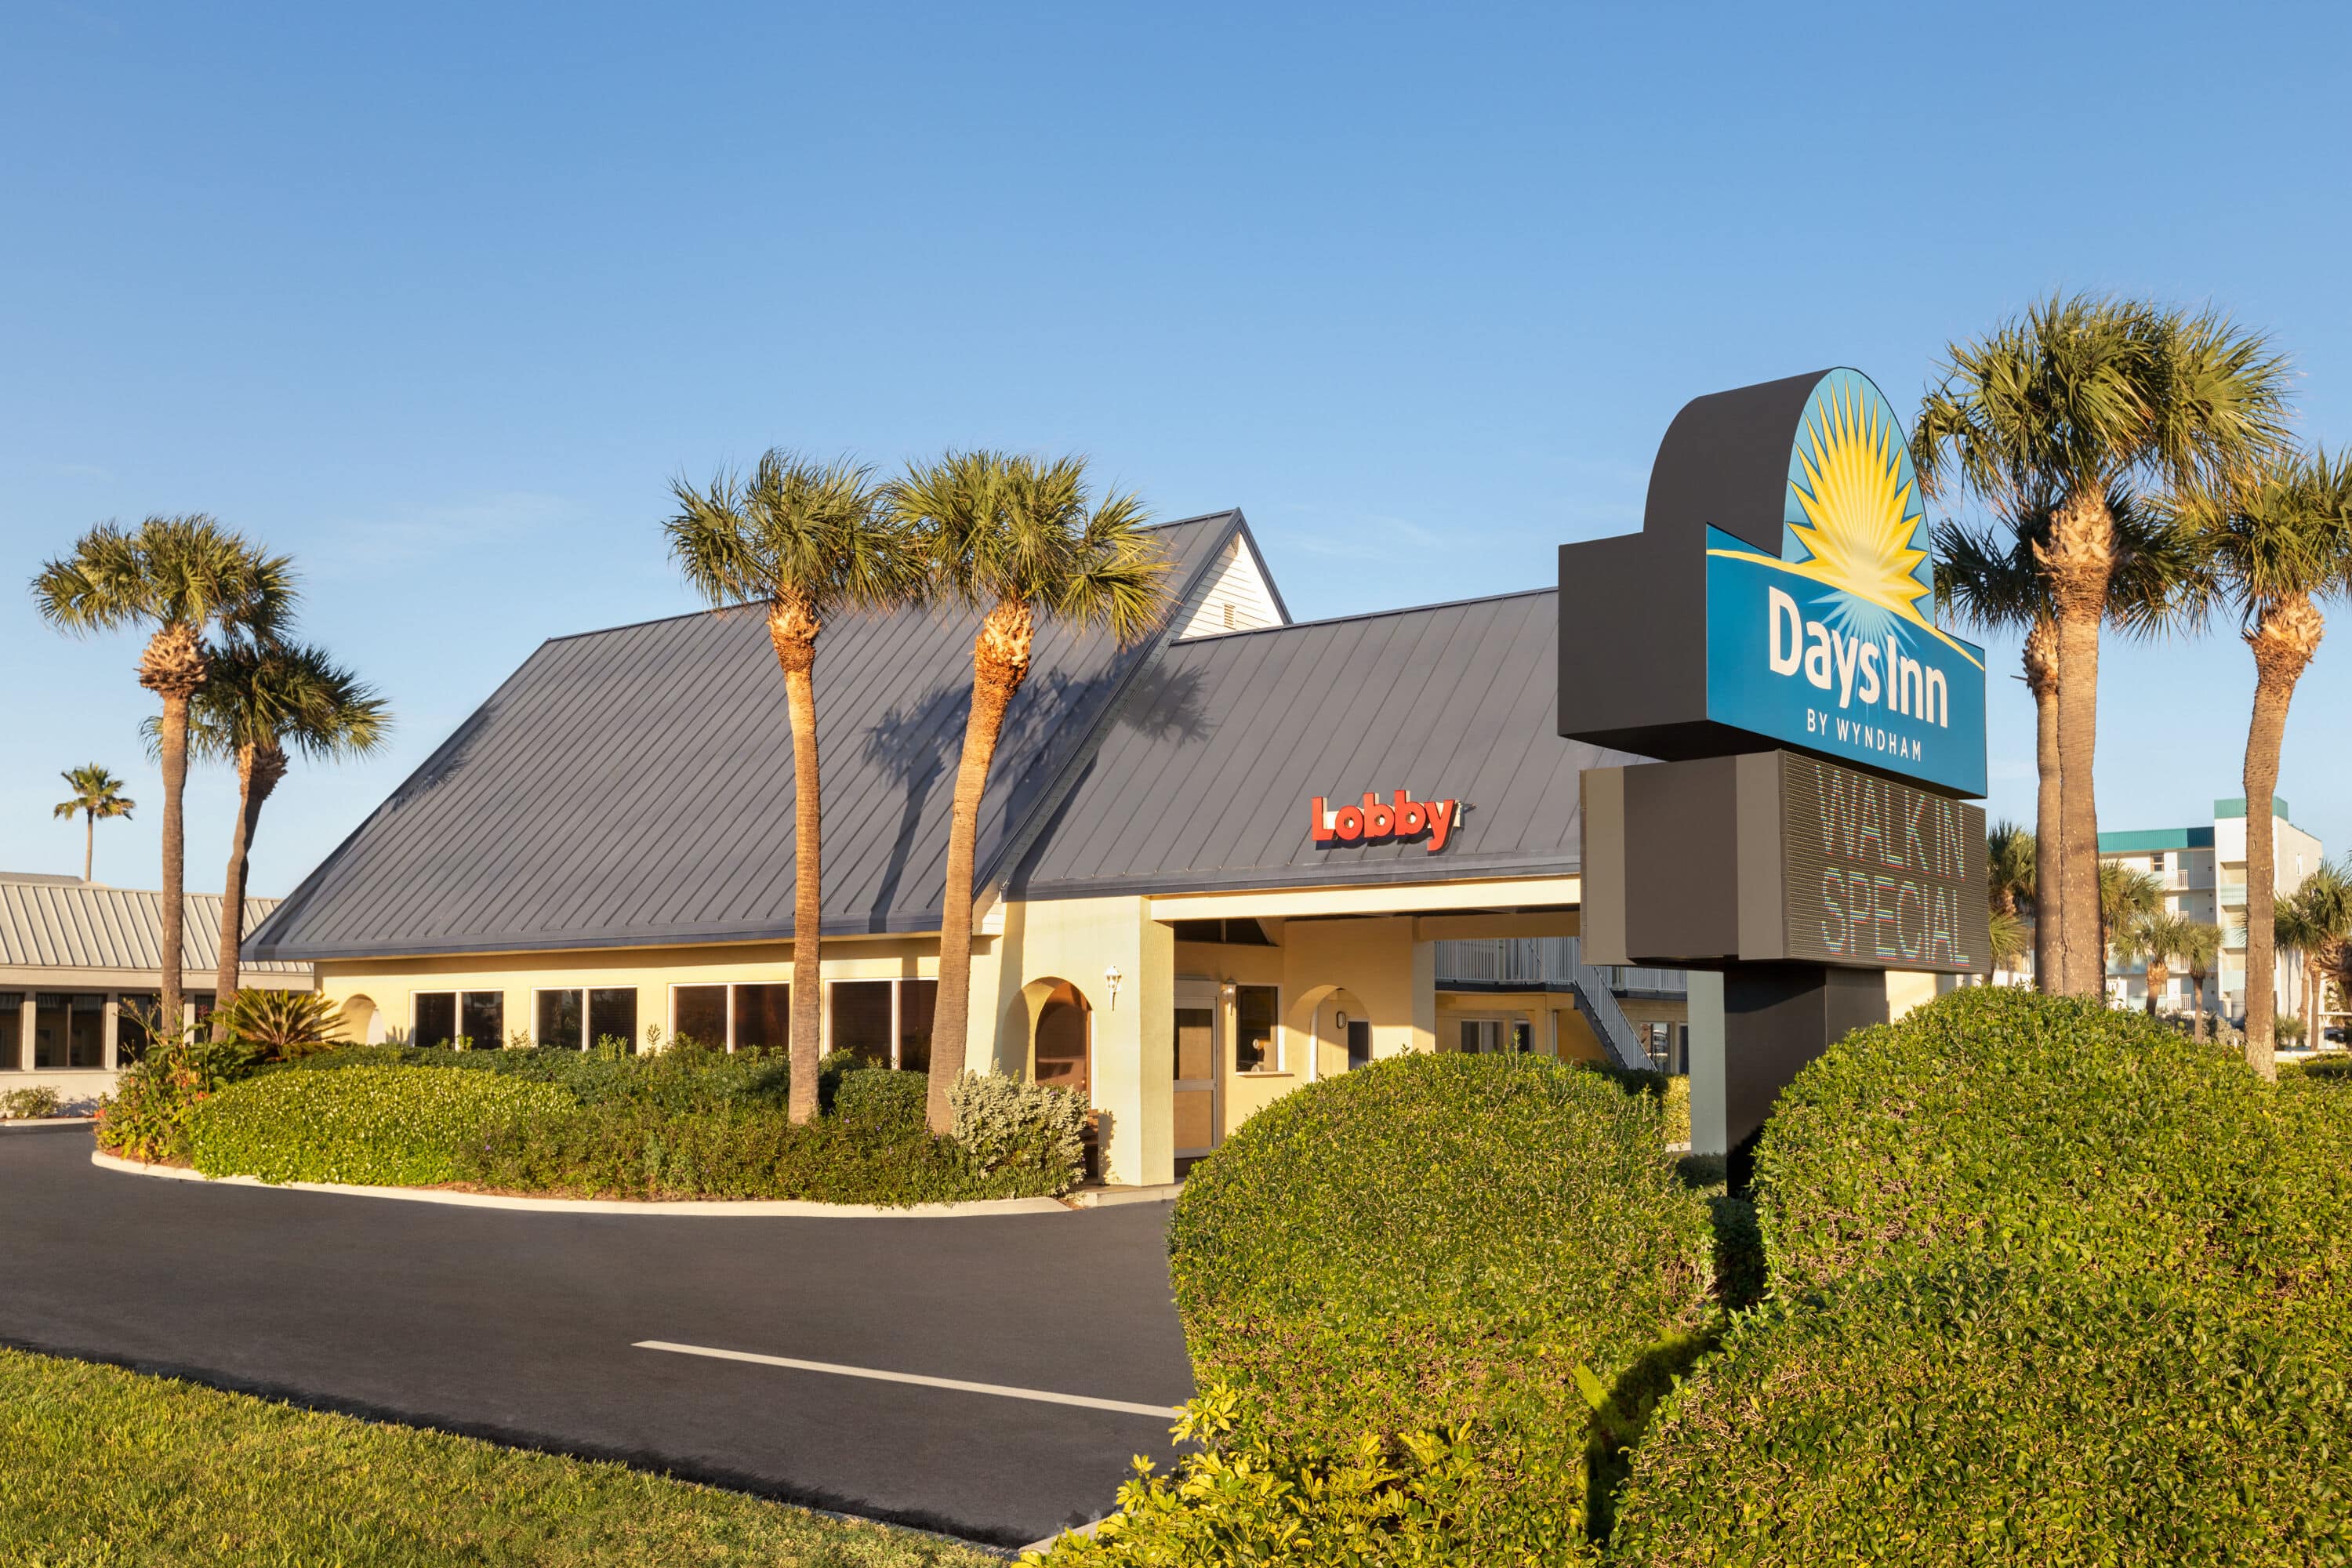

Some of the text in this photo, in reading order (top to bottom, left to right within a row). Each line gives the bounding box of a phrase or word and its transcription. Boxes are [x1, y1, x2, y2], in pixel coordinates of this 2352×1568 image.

[1769, 585, 1948, 728] Days Inn
[1807, 708, 1921, 762] BY WYNDHAM
[1311, 789, 1455, 851] Lobby
[1815, 764, 1929, 874] WALK
[1821, 866, 1970, 967] SPECIAL
